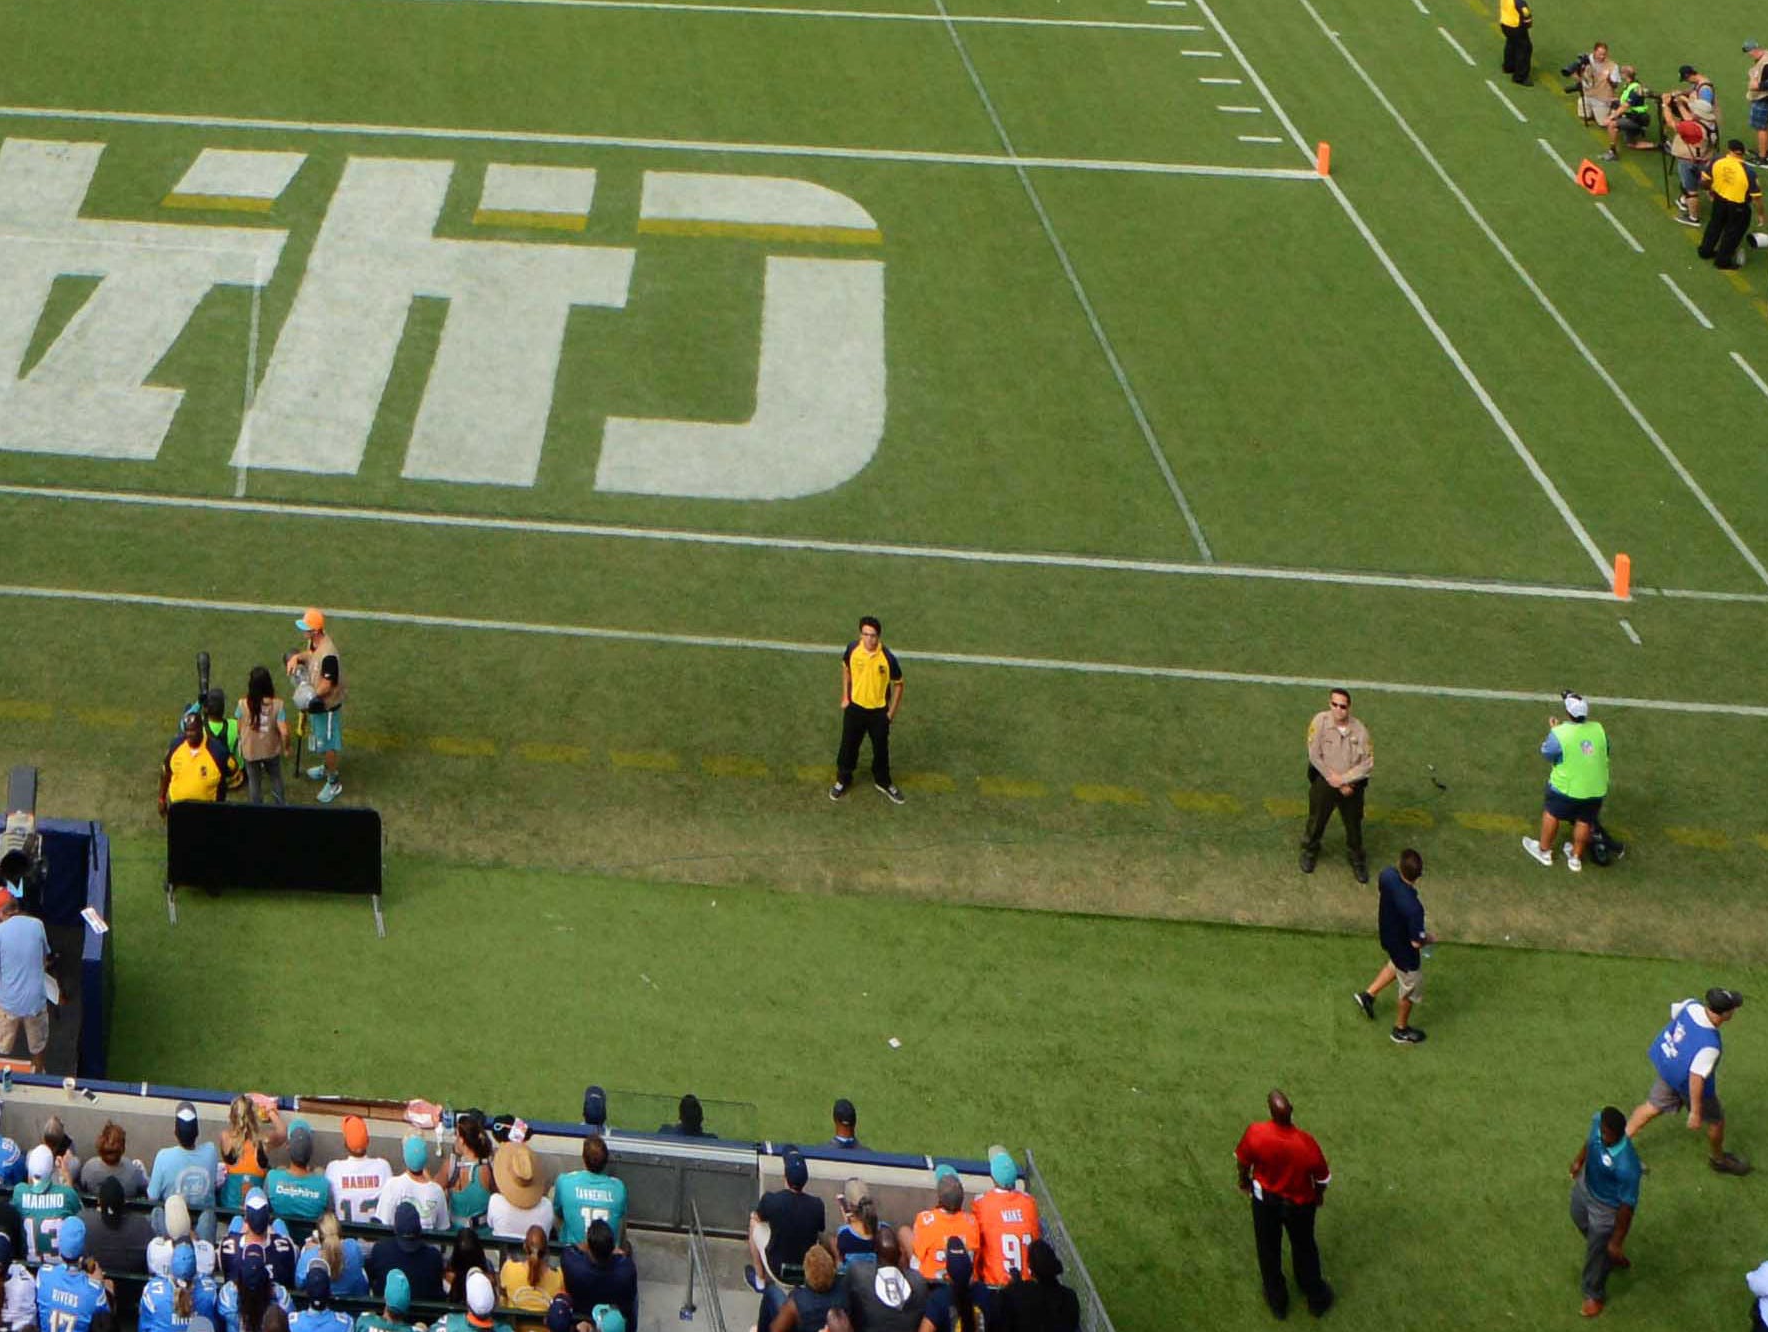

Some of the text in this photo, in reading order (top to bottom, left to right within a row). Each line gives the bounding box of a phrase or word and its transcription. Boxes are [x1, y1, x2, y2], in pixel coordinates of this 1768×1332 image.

[1582, 164, 1598, 191] G
[341, 1174, 380, 1189] MARINO
[21, 1191, 65, 1210] MARINO
[275, 1184, 321, 1199] Dolphins
[1000, 1208, 1023, 1223] WAKE
[23, 1218, 60, 1262] 13
[51, 1289, 79, 1308] RIVERS
[49, 1312, 76, 1332] 17
